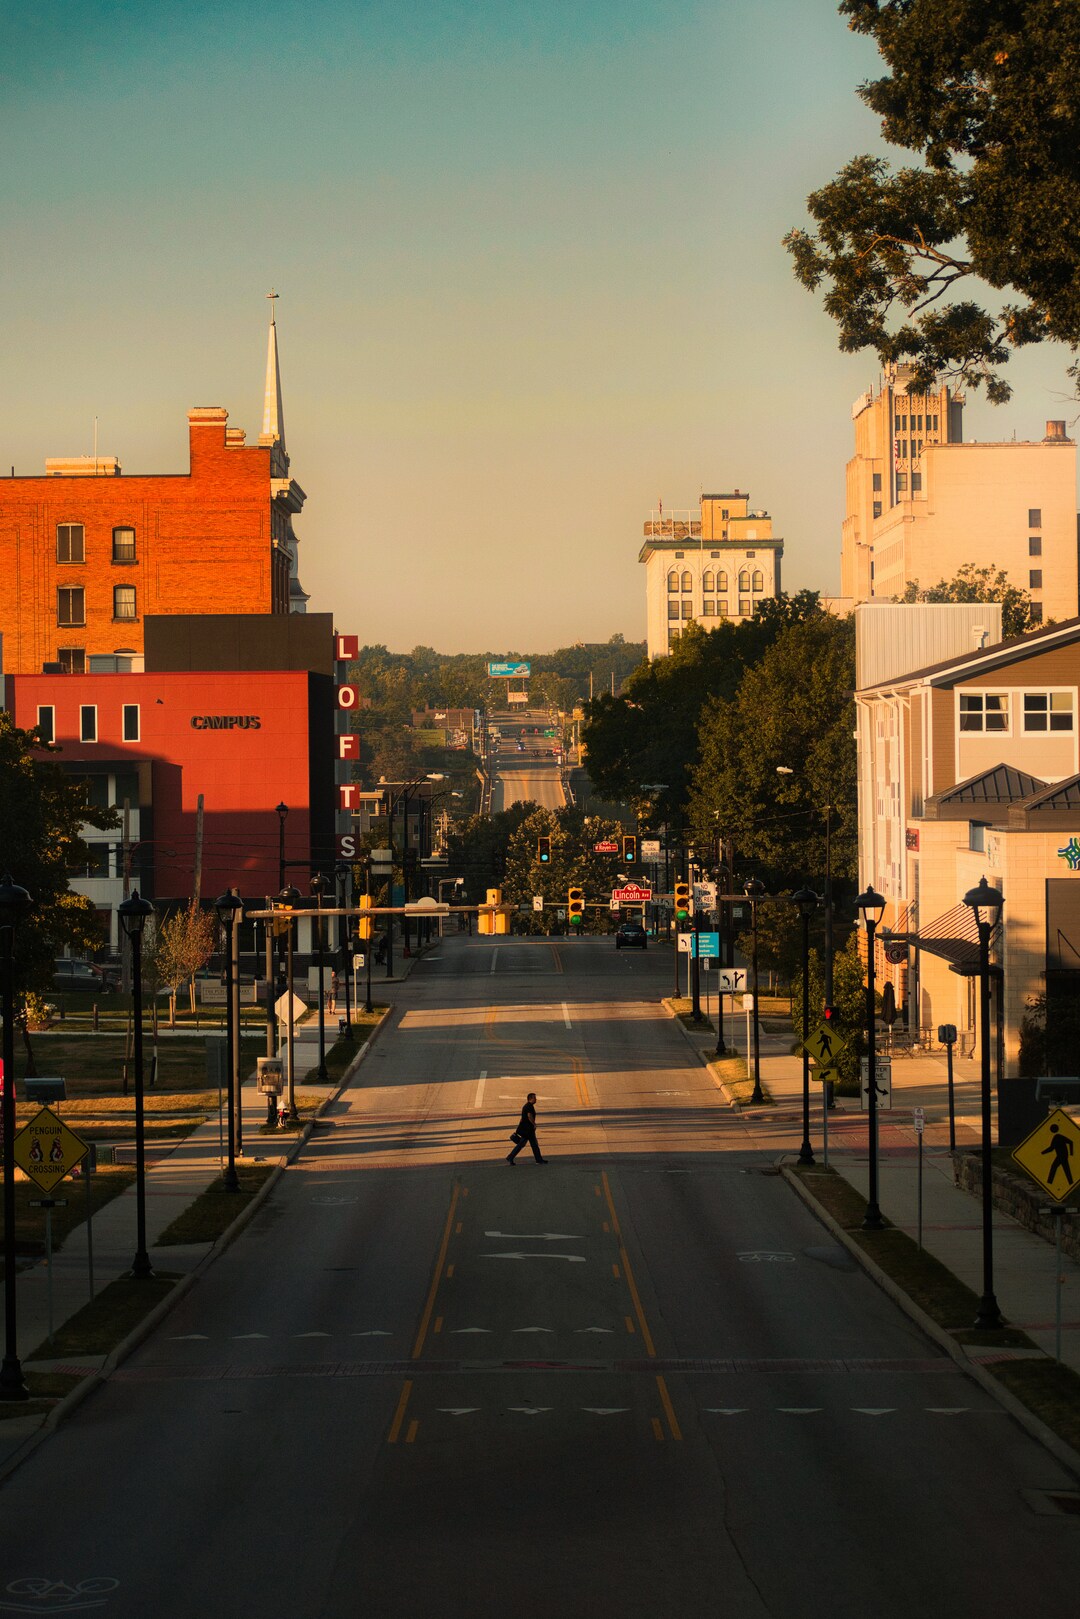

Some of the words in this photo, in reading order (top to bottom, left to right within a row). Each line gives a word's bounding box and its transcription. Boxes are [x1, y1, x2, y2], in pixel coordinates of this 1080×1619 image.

[190, 715, 261, 729] CAMPUS
[338, 638, 355, 857] LOFTS
[615, 890, 640, 899] Lincoln
[29, 1127, 62, 1135] PENGUIN
[28, 1165, 65, 1174] CROSSING
